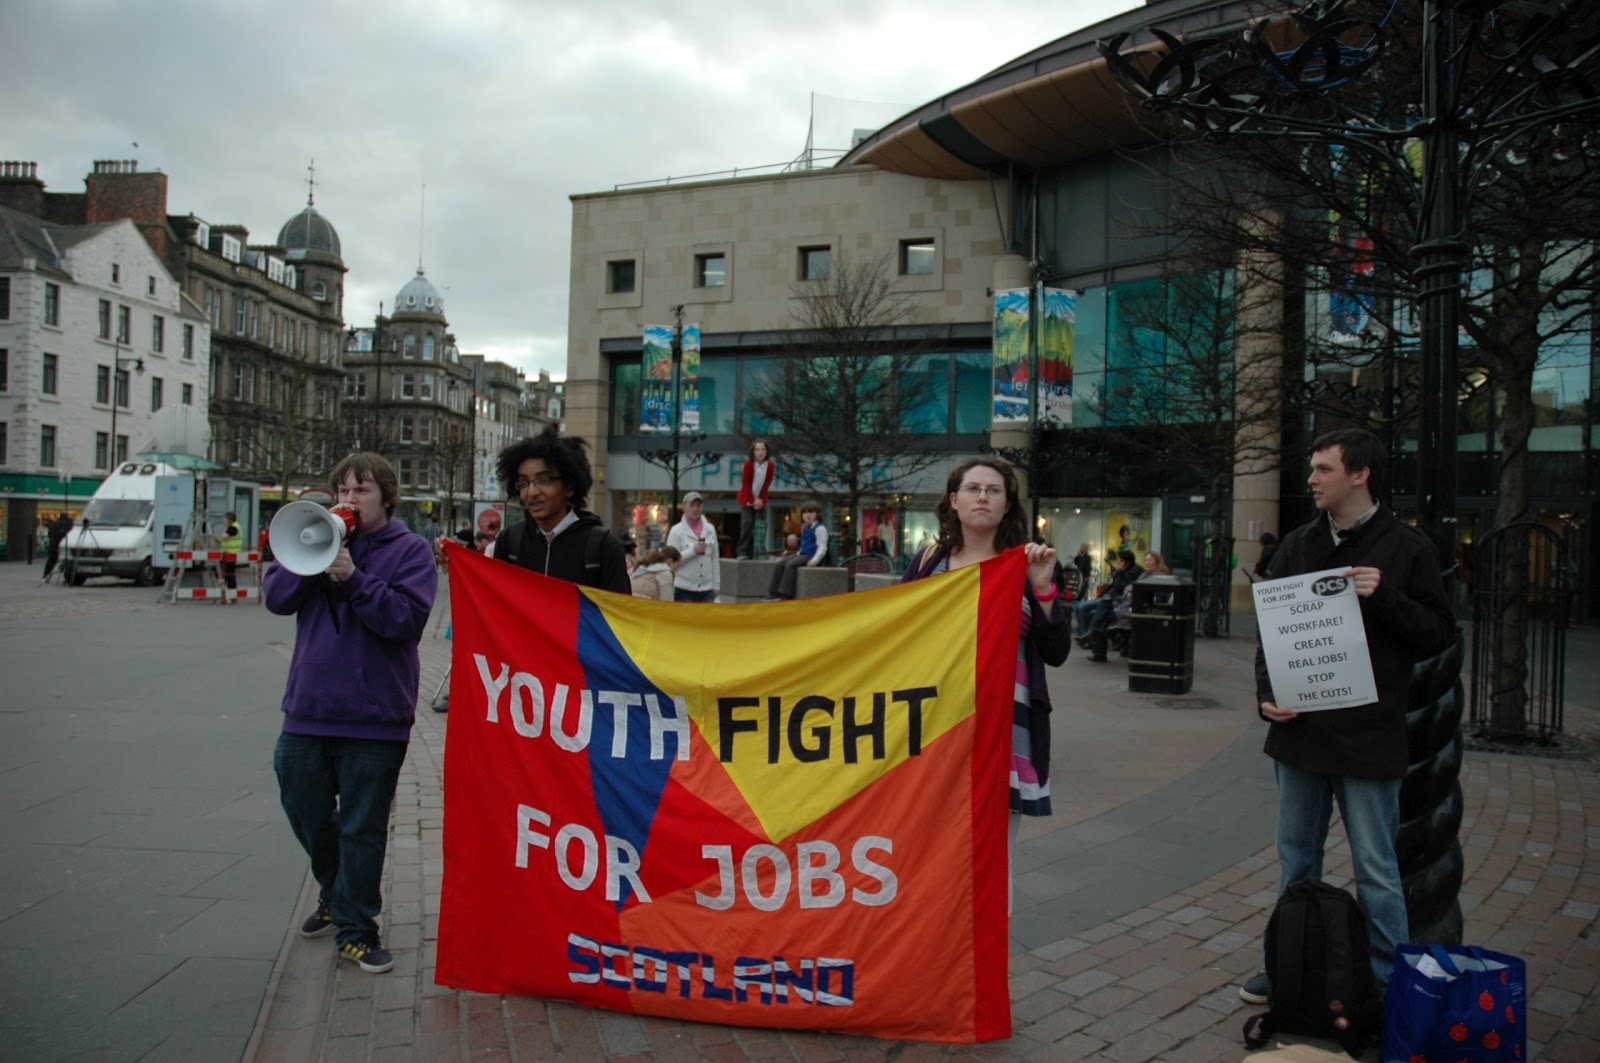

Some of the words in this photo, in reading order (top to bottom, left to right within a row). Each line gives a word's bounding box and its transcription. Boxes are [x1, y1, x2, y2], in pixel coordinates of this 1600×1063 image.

[1257, 586, 1282, 596] YOUTH
[1283, 582, 1304, 592] FIGHT
[1315, 578, 1346, 595] pcs
[1279, 593, 1297, 602] JOBS
[1290, 601, 1324, 615] SCRAP
[1278, 616, 1344, 635] WORKFARE!
[1294, 636, 1335, 651] CREATE
[1288, 658, 1315, 669] REAL
[1318, 652, 1348, 665] JOBS!
[1307, 672, 1335, 684] STOP
[1297, 691, 1318, 701] THE
[1320, 686, 1352, 699] CUTS!
[473, 653, 691, 761] YOUTH
[717, 685, 938, 765] FIGHT
[515, 803, 653, 904] FOR
[695, 835, 898, 912] JOBS
[567, 932, 854, 1007] SCOTLAND
